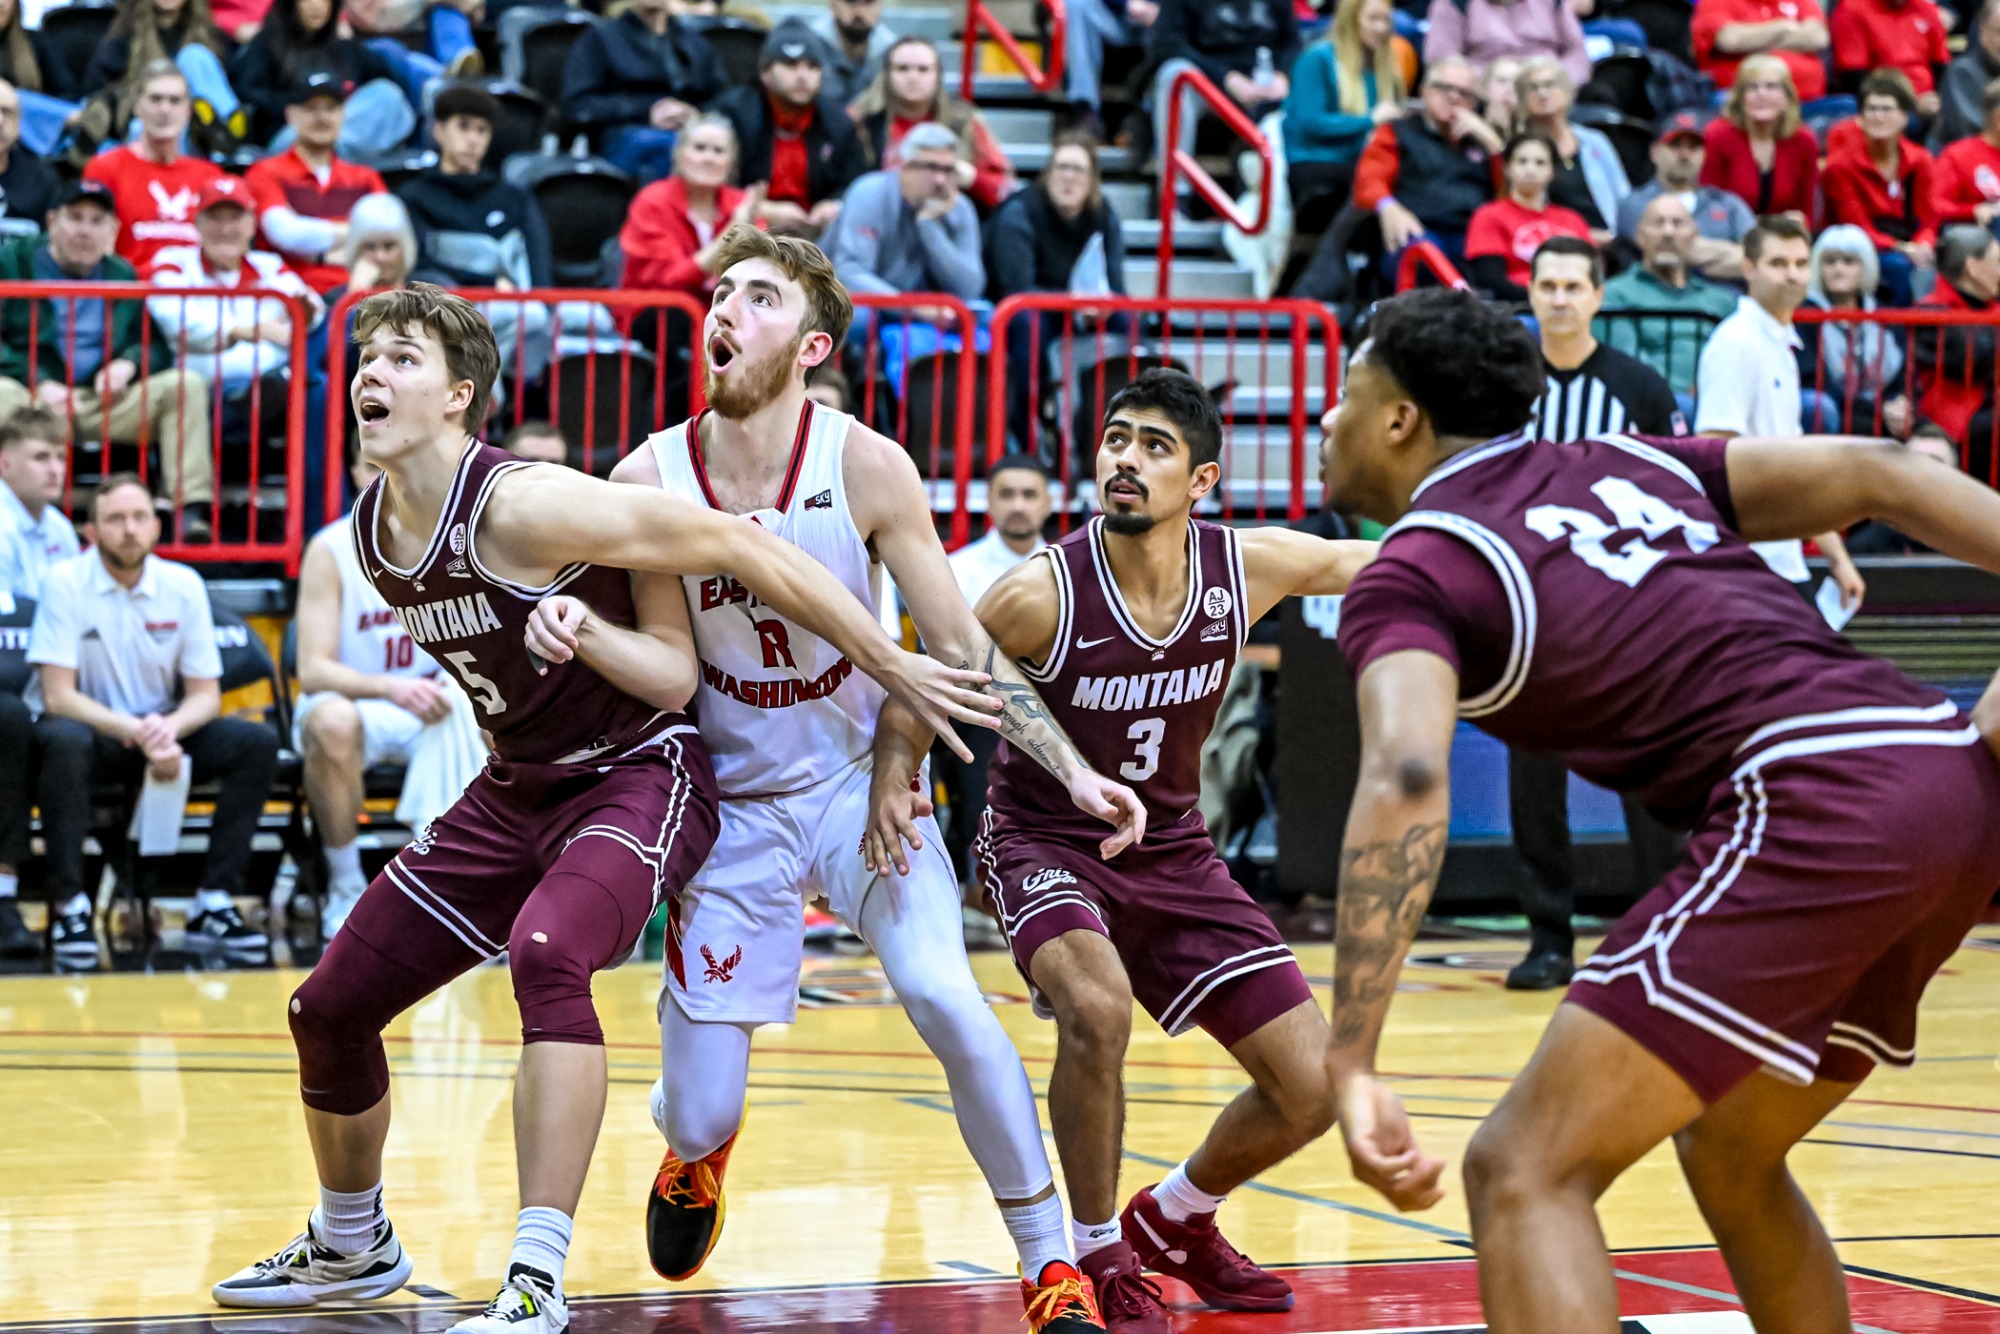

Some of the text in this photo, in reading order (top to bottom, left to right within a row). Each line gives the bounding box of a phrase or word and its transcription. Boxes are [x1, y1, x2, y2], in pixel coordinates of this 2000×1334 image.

[1525, 475, 1722, 589] 24
[1209, 589, 1225, 603] AJ
[1209, 603, 1226, 617] 23
[384, 634, 413, 673] 10
[443, 650, 507, 716] 5
[1071, 658, 1225, 712] MONTANA
[1119, 717, 1167, 782] 3
